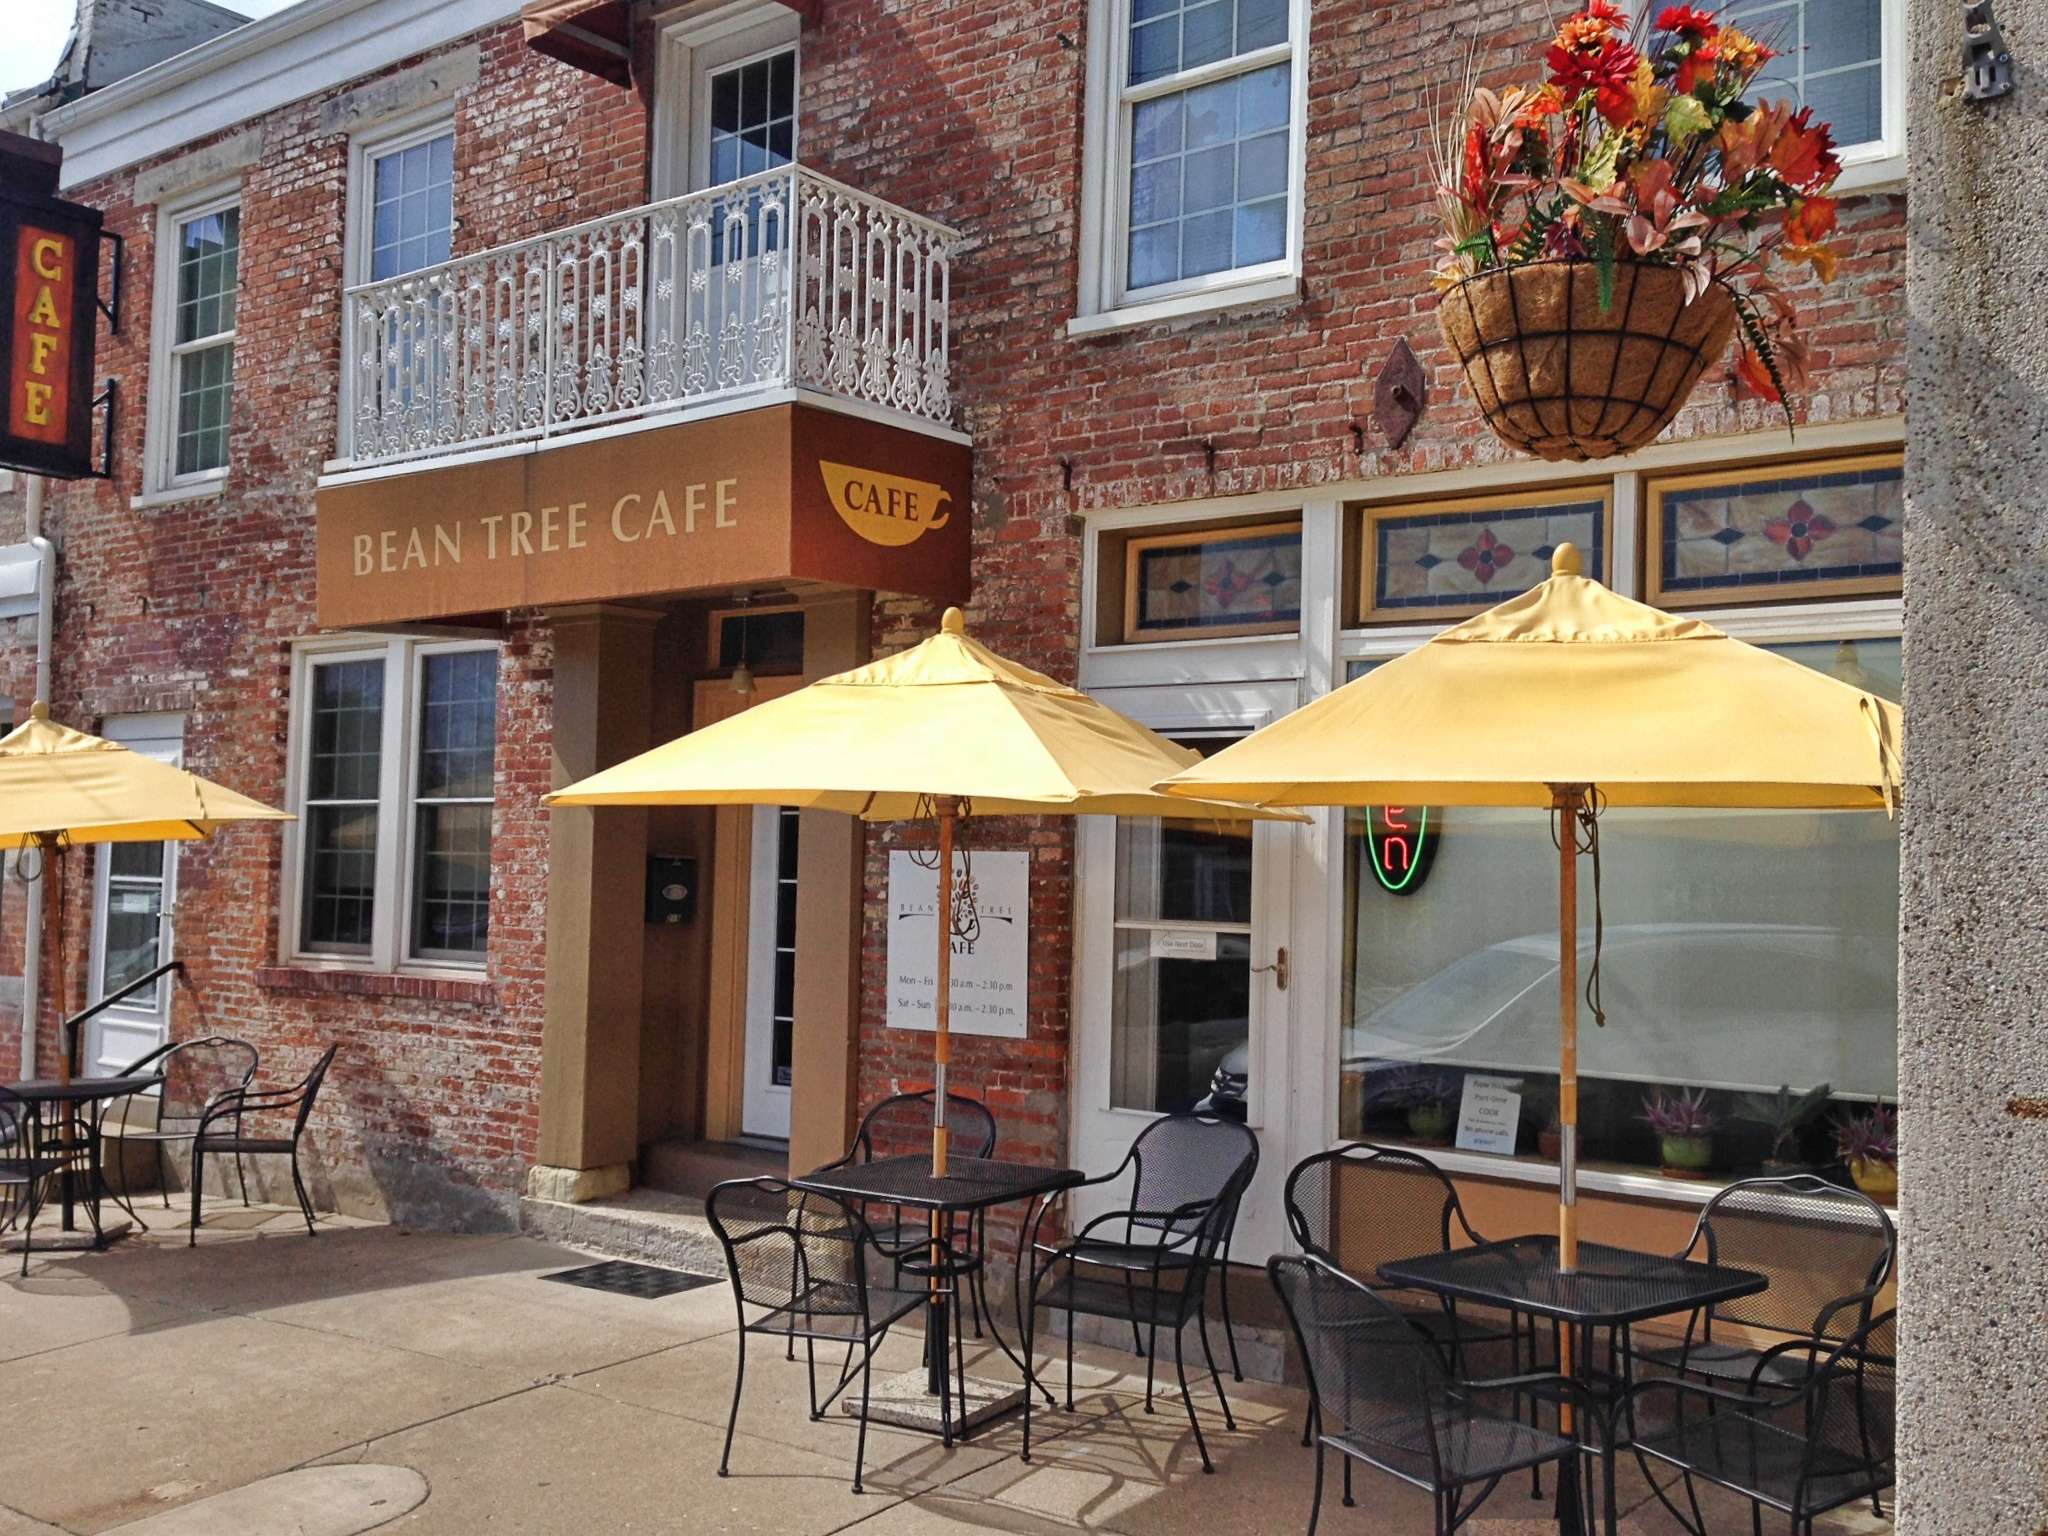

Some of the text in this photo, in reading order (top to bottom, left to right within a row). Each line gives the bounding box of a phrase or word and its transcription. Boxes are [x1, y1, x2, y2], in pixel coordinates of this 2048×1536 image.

[24, 238, 64, 426] CAFE
[843, 479, 920, 522] CAFE
[353, 477, 737, 577] BEAN TREE CAFE
[1384, 805, 1408, 870] en
[900, 904, 1012, 915] BEAN TREE
[950, 941, 976, 955] AFE
[899, 975, 916, 985] Mon
